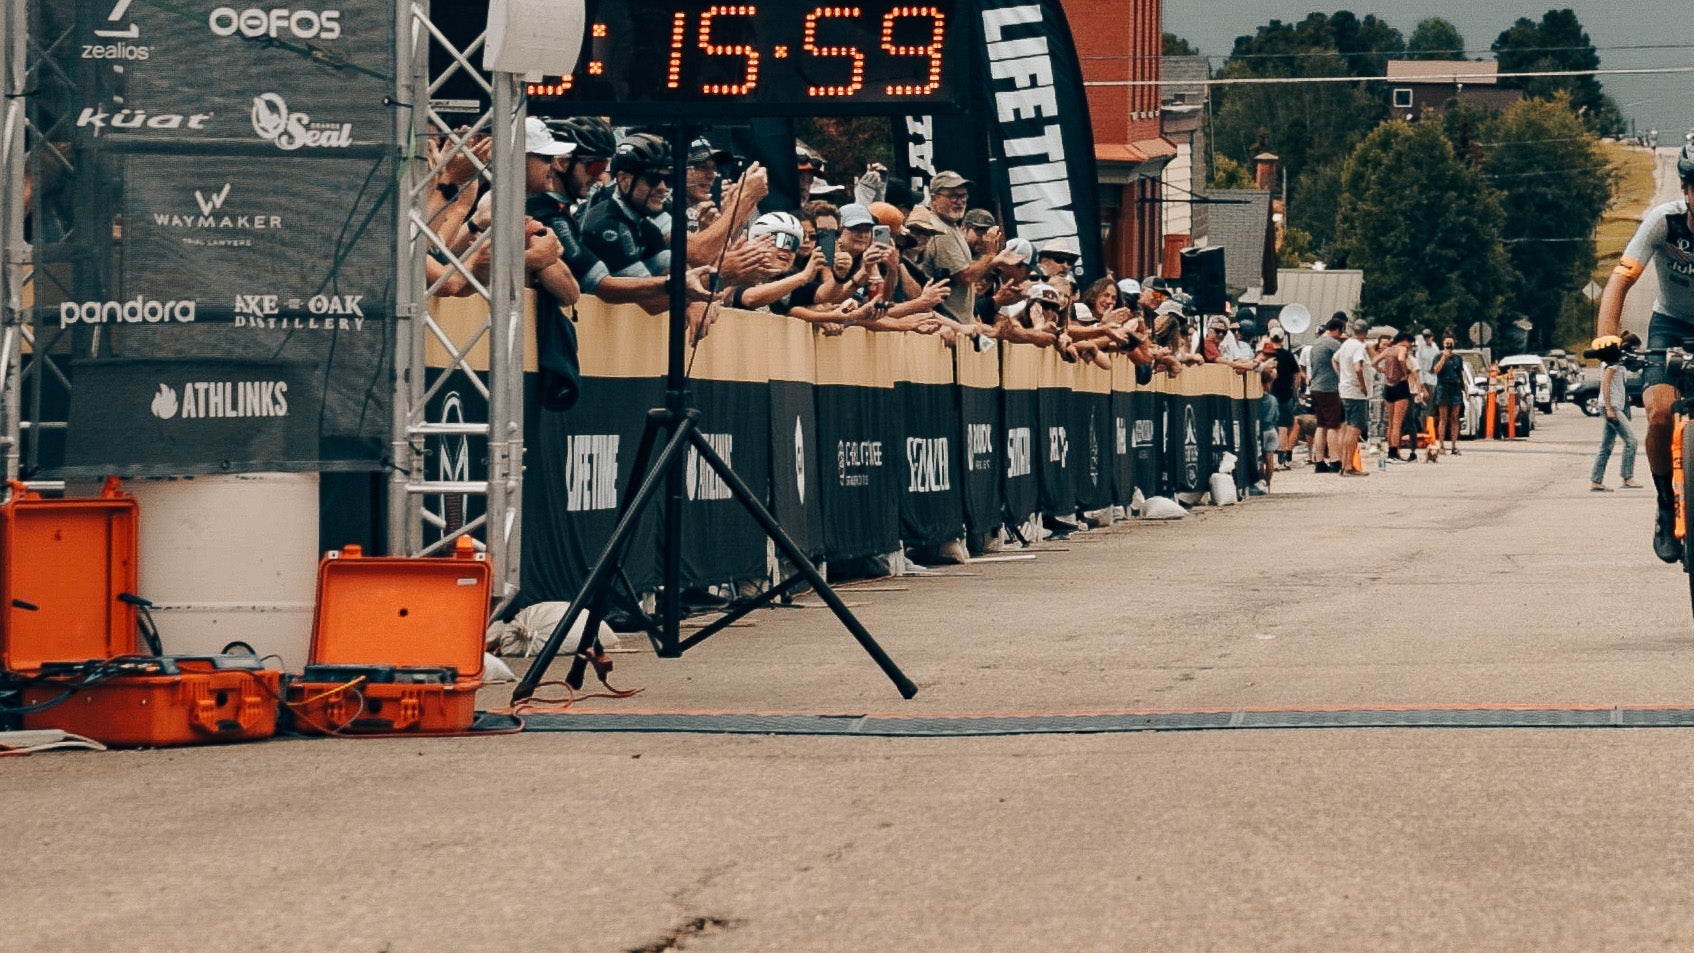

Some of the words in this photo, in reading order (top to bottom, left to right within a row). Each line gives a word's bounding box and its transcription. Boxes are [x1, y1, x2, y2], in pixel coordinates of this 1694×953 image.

[81, 42, 150, 60] zealios
[274, 112, 353, 150] Seal
[154, 213, 282, 229] WAYMAKER
[61, 294, 196, 329] pandora
[234, 294, 279, 317] AXE
[308, 294, 364, 316] OAK
[234, 315, 365, 331] DISTILLERY
[182, 380, 288, 419] ATHLINKS
